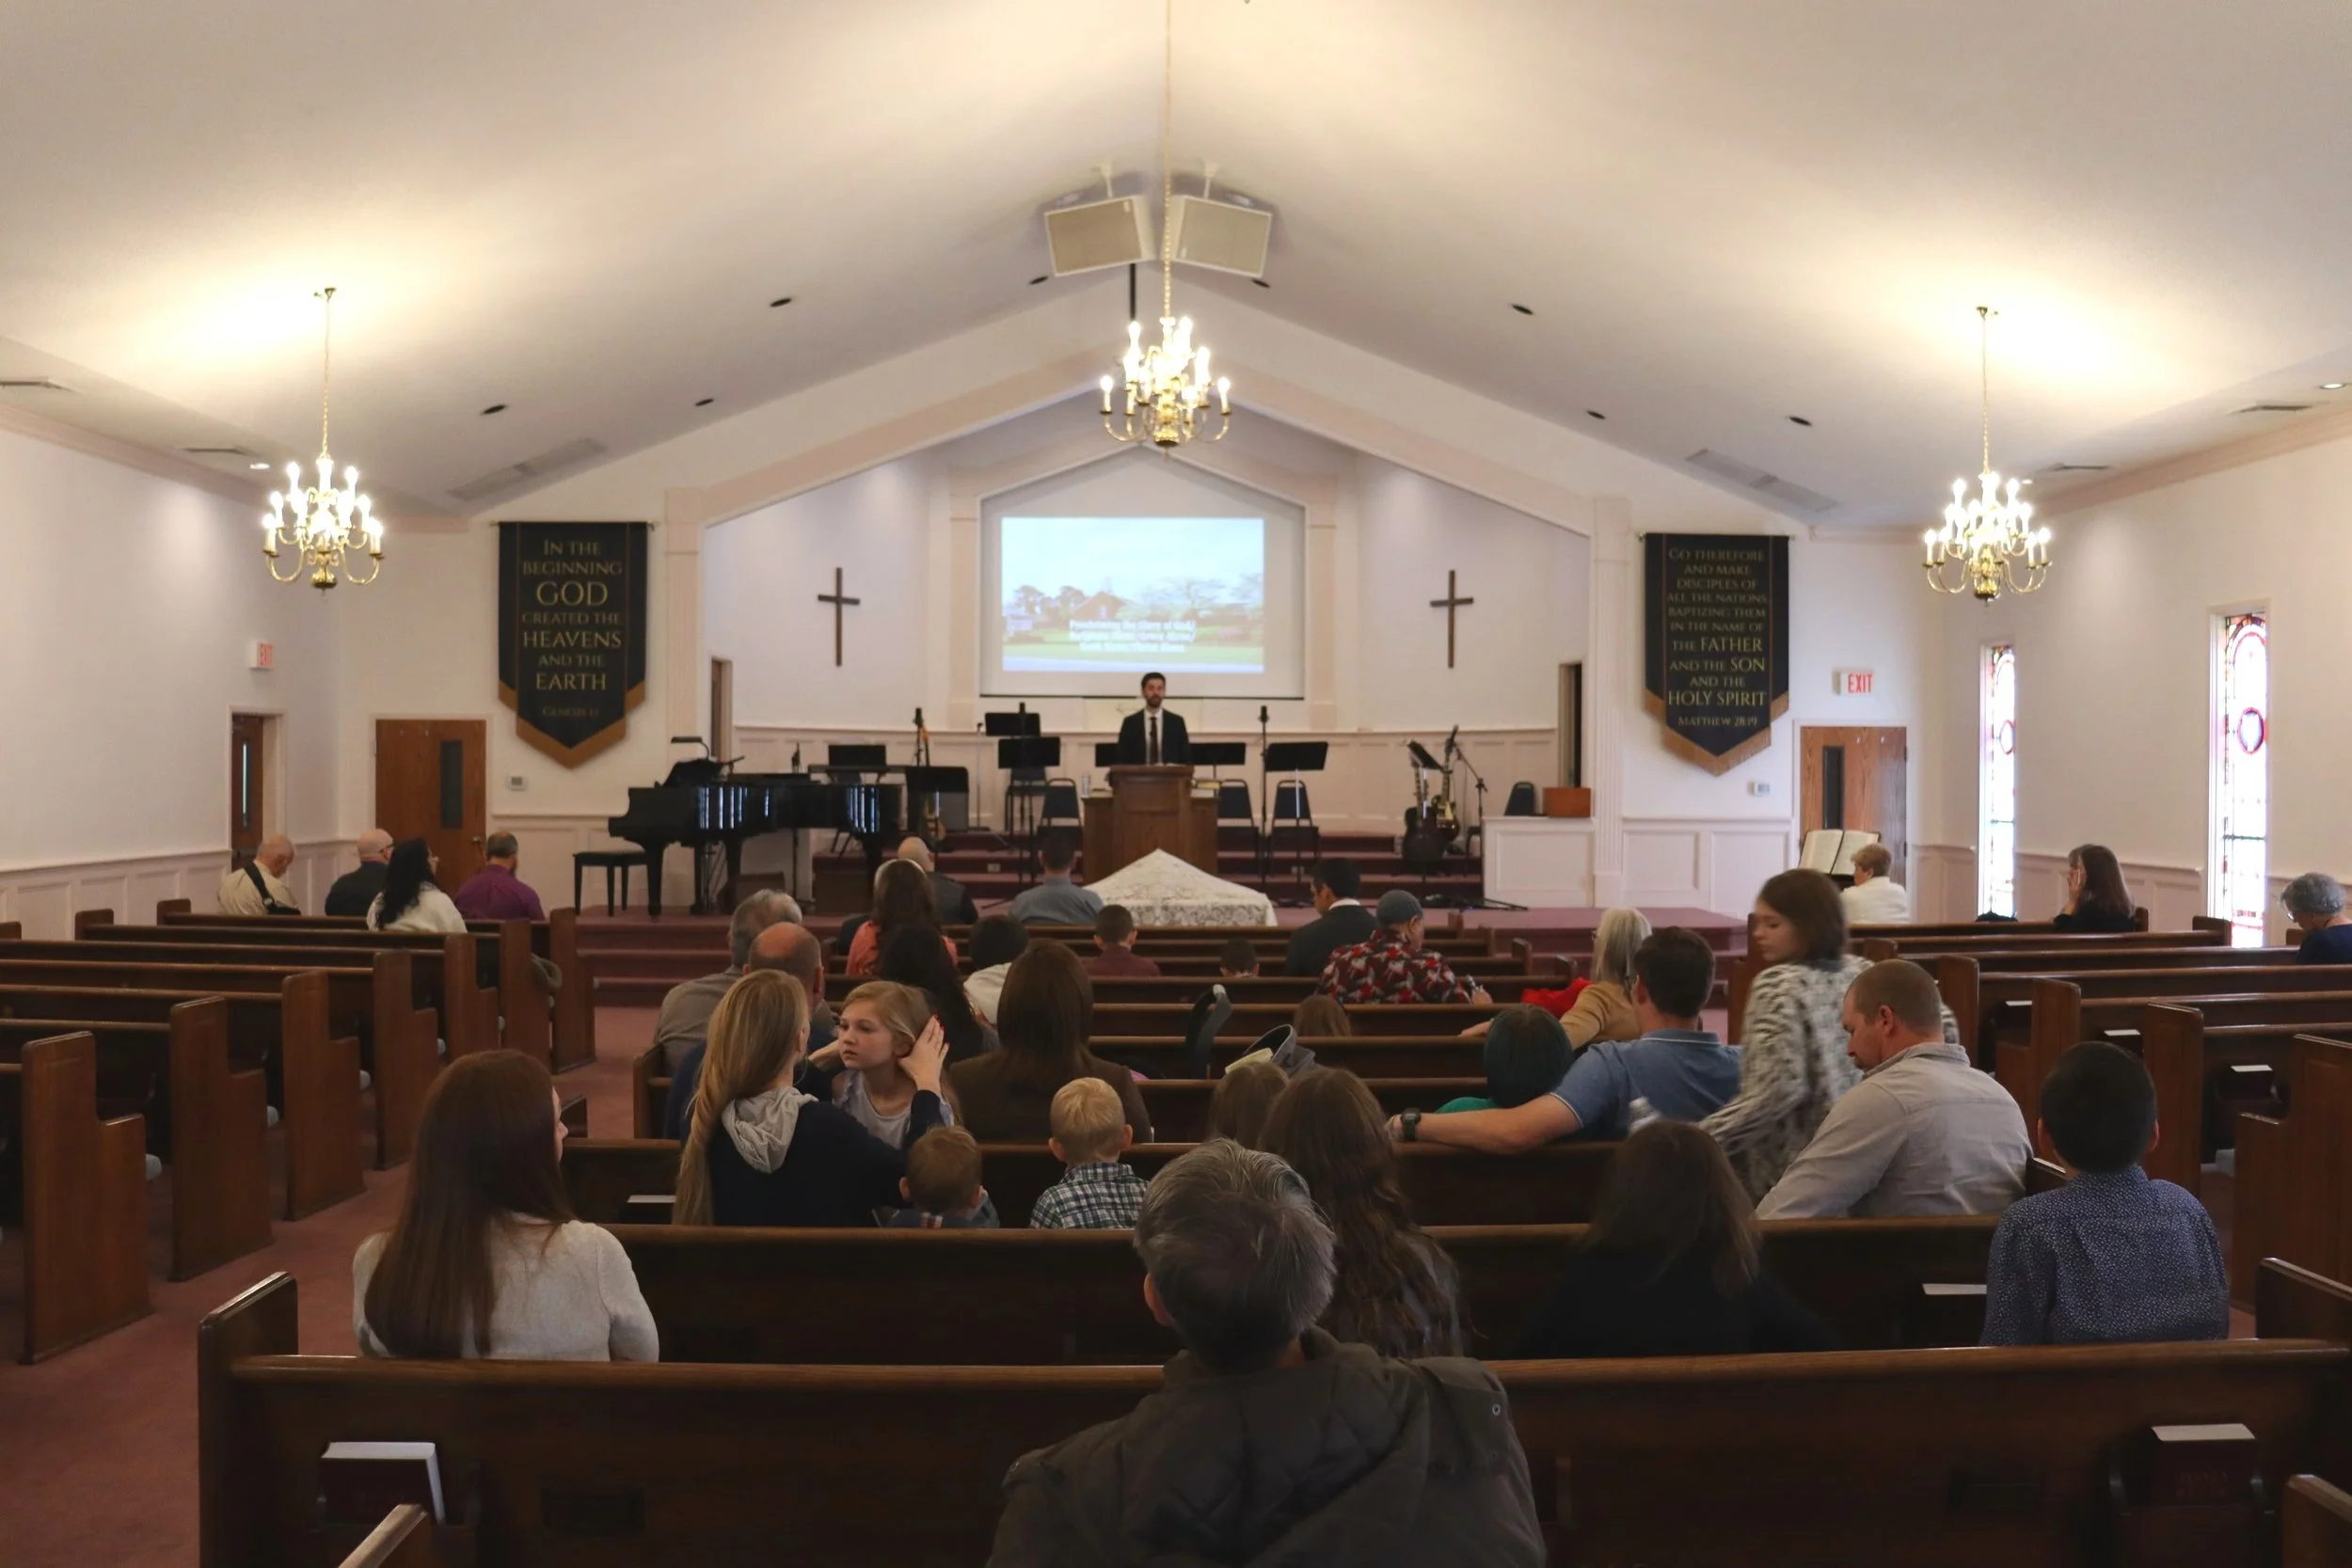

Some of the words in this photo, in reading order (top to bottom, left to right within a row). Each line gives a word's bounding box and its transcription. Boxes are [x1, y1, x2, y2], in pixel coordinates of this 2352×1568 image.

[544, 539, 564, 556] IN
[568, 541, 601, 556] THE
[1668, 547, 1691, 561] GO
[1694, 549, 1764, 562] THEREFORE
[523, 561, 623, 576] BEGINNING
[1684, 564, 1714, 576] AND
[1716, 564, 1752, 576] MAKE
[1677, 578, 1739, 590] DISCIPLES
[1740, 578, 1758, 590] OF
[536, 580, 609, 607] GOD
[1667, 592, 1686, 604] ALL
[1691, 593, 1712, 604] THE
[1715, 593, 1768, 604] NATIONS
[521, 611, 590, 626] CREATED
[593, 611, 621, 626] THE
[1668, 607, 1731, 618] BAPTIZING
[1734, 607, 1767, 618] THEM
[1670, 621, 1684, 632] IN
[1688, 621, 1708, 632] THE
[1711, 621, 1746, 632] NAME
[1748, 622, 1764, 633] OF
[523, 630, 622, 649] HEAVENS
[1673, 640, 1696, 651] THE
[1700, 637, 1763, 653] FATHER
[538, 654, 572, 667] AND
[576, 654, 605, 668] THE
[1670, 659, 1699, 672] AND
[1703, 659, 1726, 672] THE
[1730, 657, 1766, 673] SON
[535, 673, 607, 691] EARTH
[1690, 676, 1719, 688] AND
[1722, 676, 1746, 688] THE
[1848, 673, 1873, 693] EXIT
[1668, 689, 1712, 706] HOLY
[1716, 690, 1767, 706] SPIRIT
[1678, 716, 1731, 727] MATTHEW
